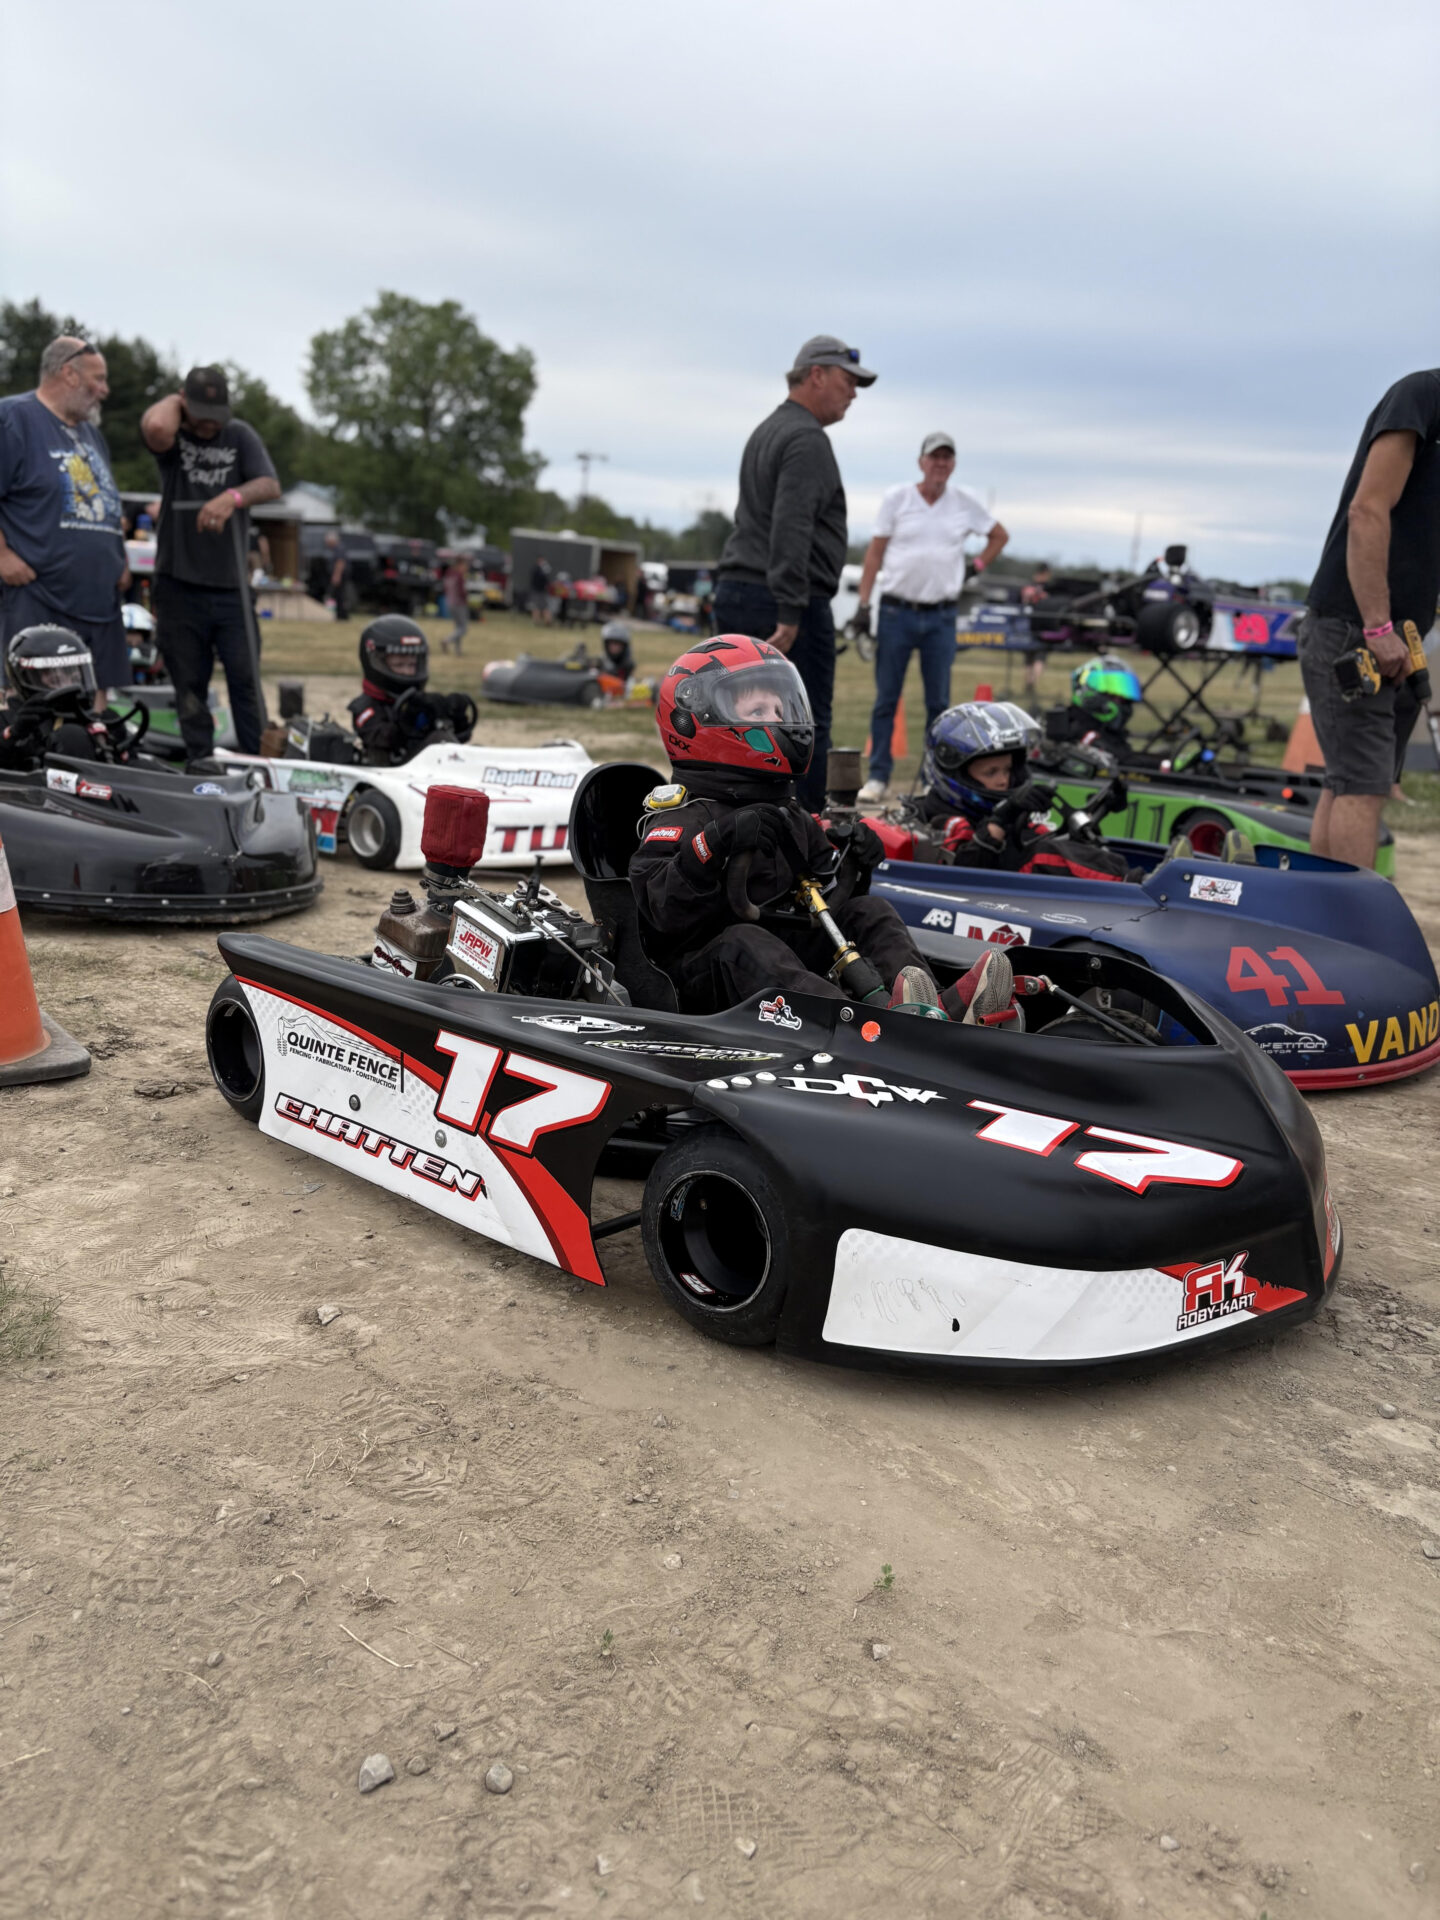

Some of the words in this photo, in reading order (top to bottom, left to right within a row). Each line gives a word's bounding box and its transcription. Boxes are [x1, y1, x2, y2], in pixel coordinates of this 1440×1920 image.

[482, 766, 538, 787] Rapid
[537, 769, 577, 789] Rad
[494, 824, 570, 853] TU
[459, 930, 493, 959] JRPW
[1226, 946, 1346, 1007] 41
[287, 1031, 346, 1063] QUINTE
[348, 1051, 400, 1083] FENCE
[289, 1047, 312, 1060] FENCING
[315, 1056, 352, 1073] FABRICATION
[355, 1070, 397, 1090] CONSTRUCTION
[434, 1029, 613, 1155] 17
[275, 1092, 484, 1202] CHATTEN
[966, 1099, 1245, 1195] 17
[1177, 1291, 1256, 1331] ROBY-KART
